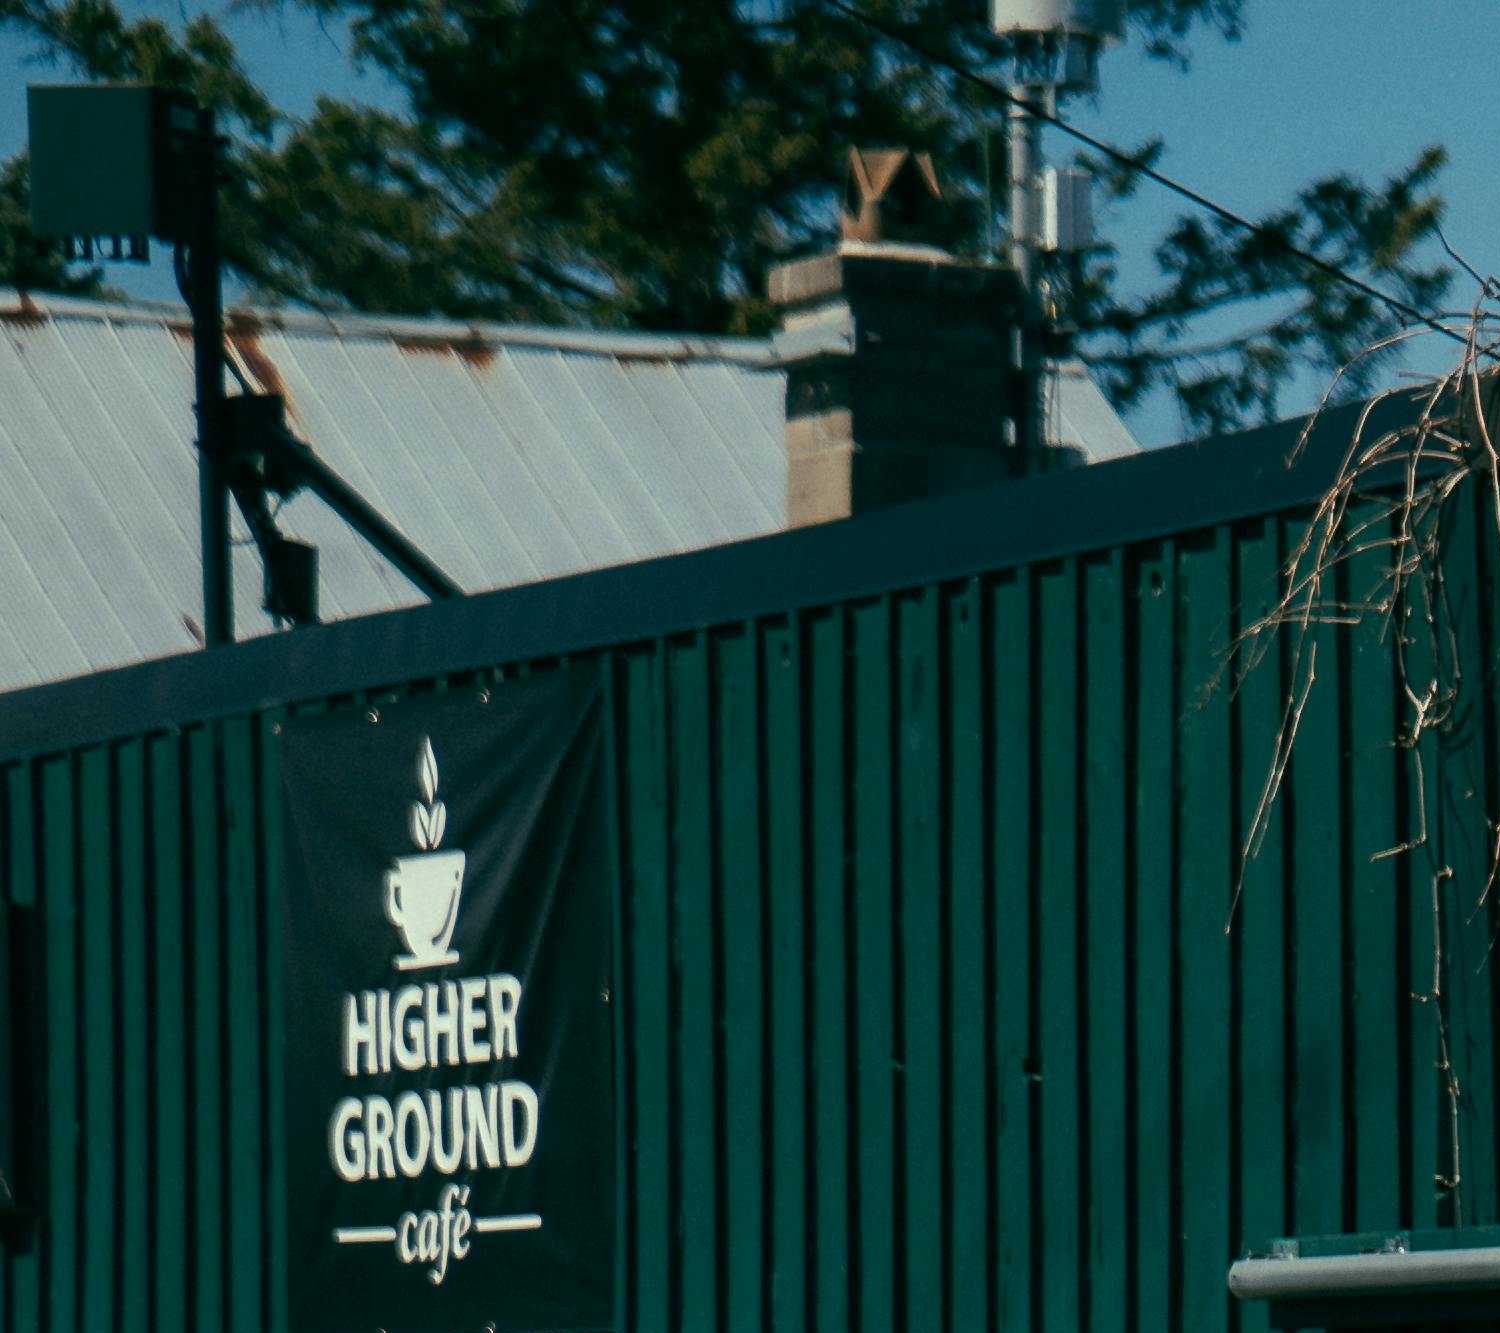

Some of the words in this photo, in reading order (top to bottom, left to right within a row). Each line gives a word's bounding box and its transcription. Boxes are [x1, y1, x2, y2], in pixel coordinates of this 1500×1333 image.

[344, 974, 522, 1076] HIGHER
[332, 1081, 540, 1182] GROUND
[398, 1184, 472, 1285] café
